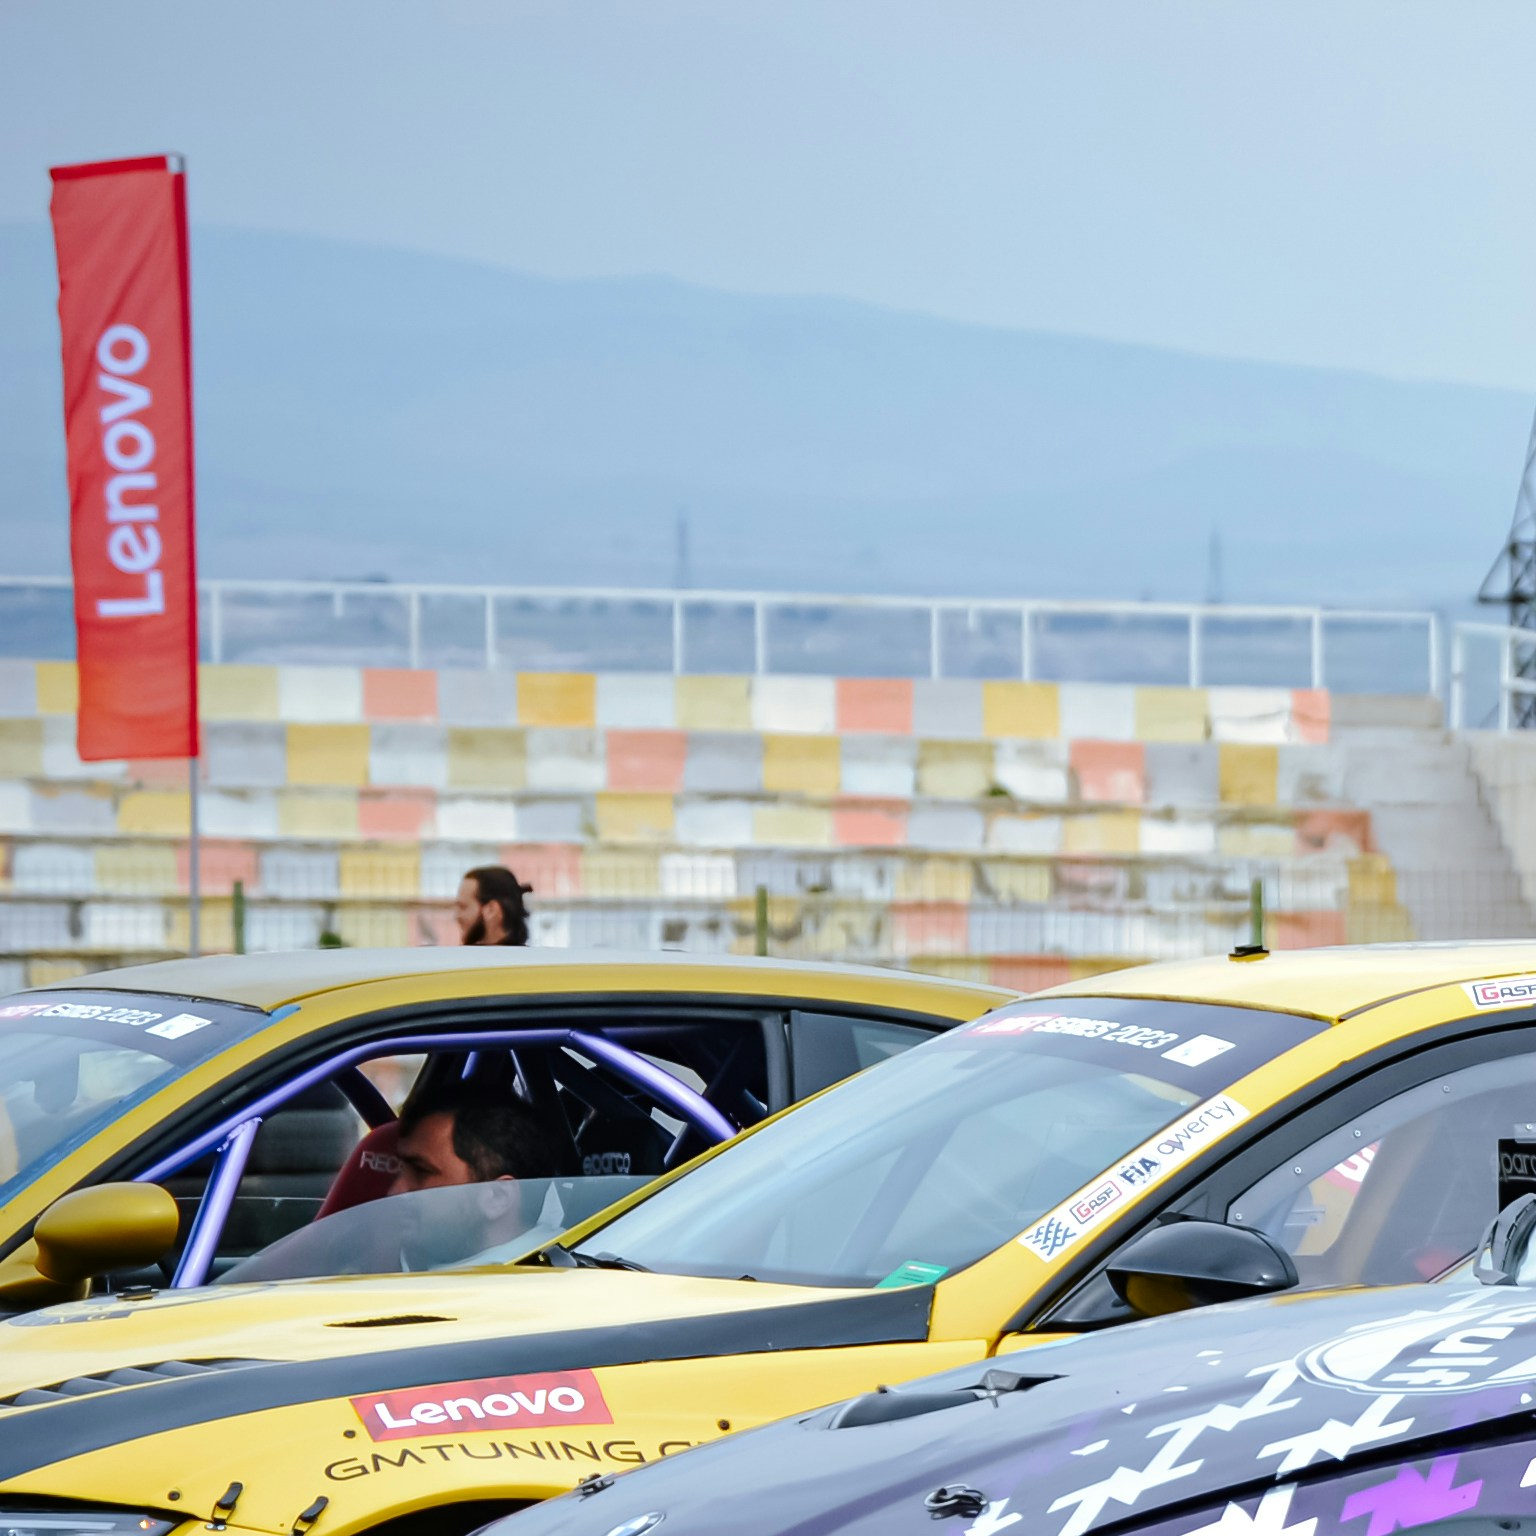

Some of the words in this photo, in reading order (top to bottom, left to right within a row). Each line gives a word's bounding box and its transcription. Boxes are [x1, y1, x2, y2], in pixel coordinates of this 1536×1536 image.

[96, 323, 166, 617] Lenovo
[1101, 1024, 1179, 1049] 2023
[1119, 1157, 1160, 1186] FIA
[1157, 1100, 1235, 1156] qwerty
[374, 1386, 585, 1430] Lenovo
